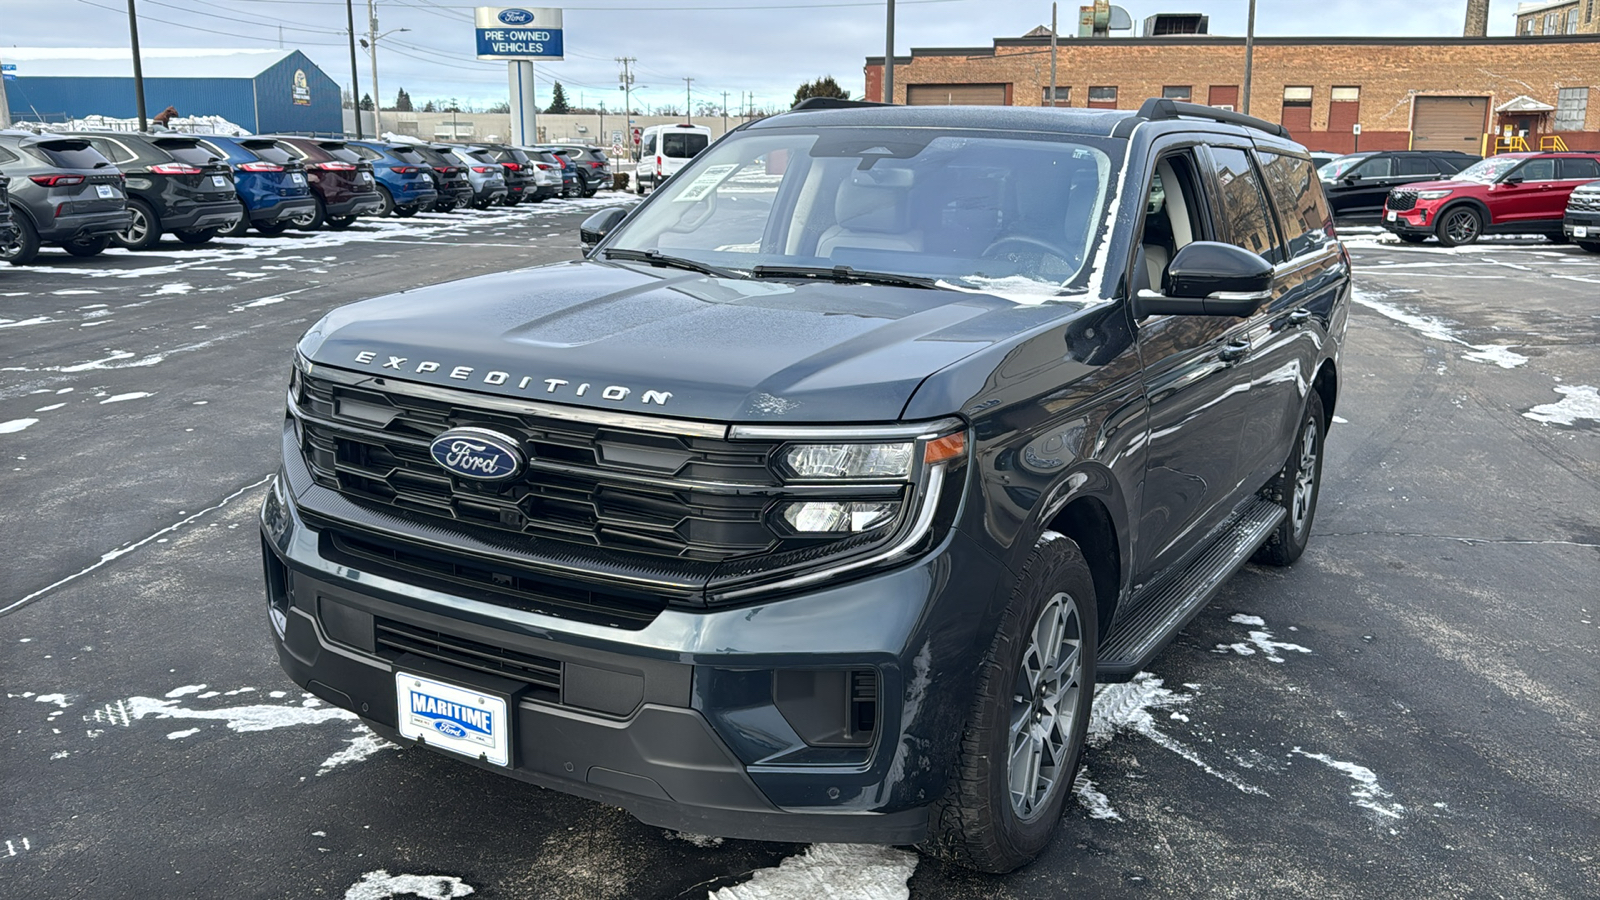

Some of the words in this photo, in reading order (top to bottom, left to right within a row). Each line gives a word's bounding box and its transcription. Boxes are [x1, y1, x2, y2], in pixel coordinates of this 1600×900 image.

[504, 11, 526, 22] Ford
[484, 31, 551, 42] PRE-OWNED
[491, 42, 544, 53] VEHICLES
[354, 351, 673, 406] EXPEDITION
[445, 440, 500, 474] Ford
[412, 692, 491, 733] MARITIME
[439, 722, 462, 737] Ford
